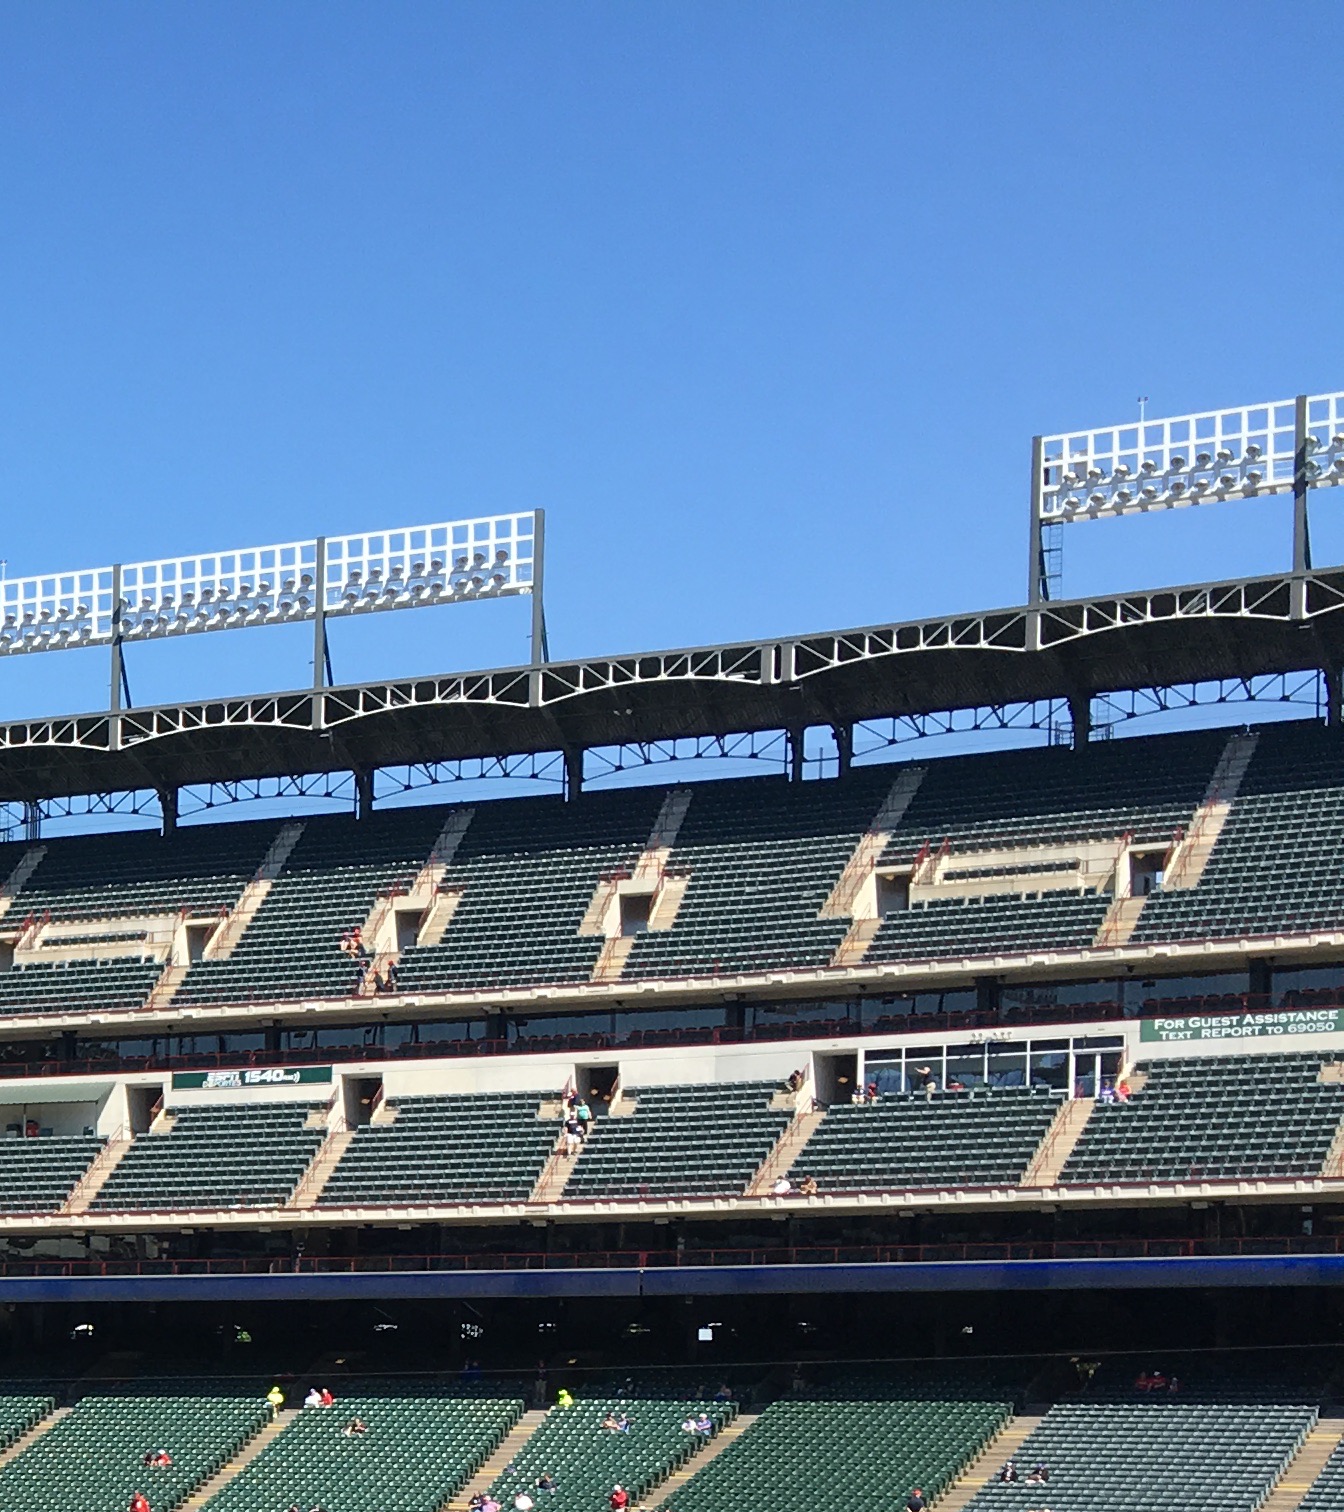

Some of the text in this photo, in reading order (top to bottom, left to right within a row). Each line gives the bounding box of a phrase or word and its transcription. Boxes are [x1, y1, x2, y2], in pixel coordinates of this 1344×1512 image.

[1154, 1009, 1339, 1030] FOR GUEST ASSISTANCE
[1159, 1022, 1336, 1041] TEXT REPORT TO 69050
[244, 1069, 285, 1084] 1540
